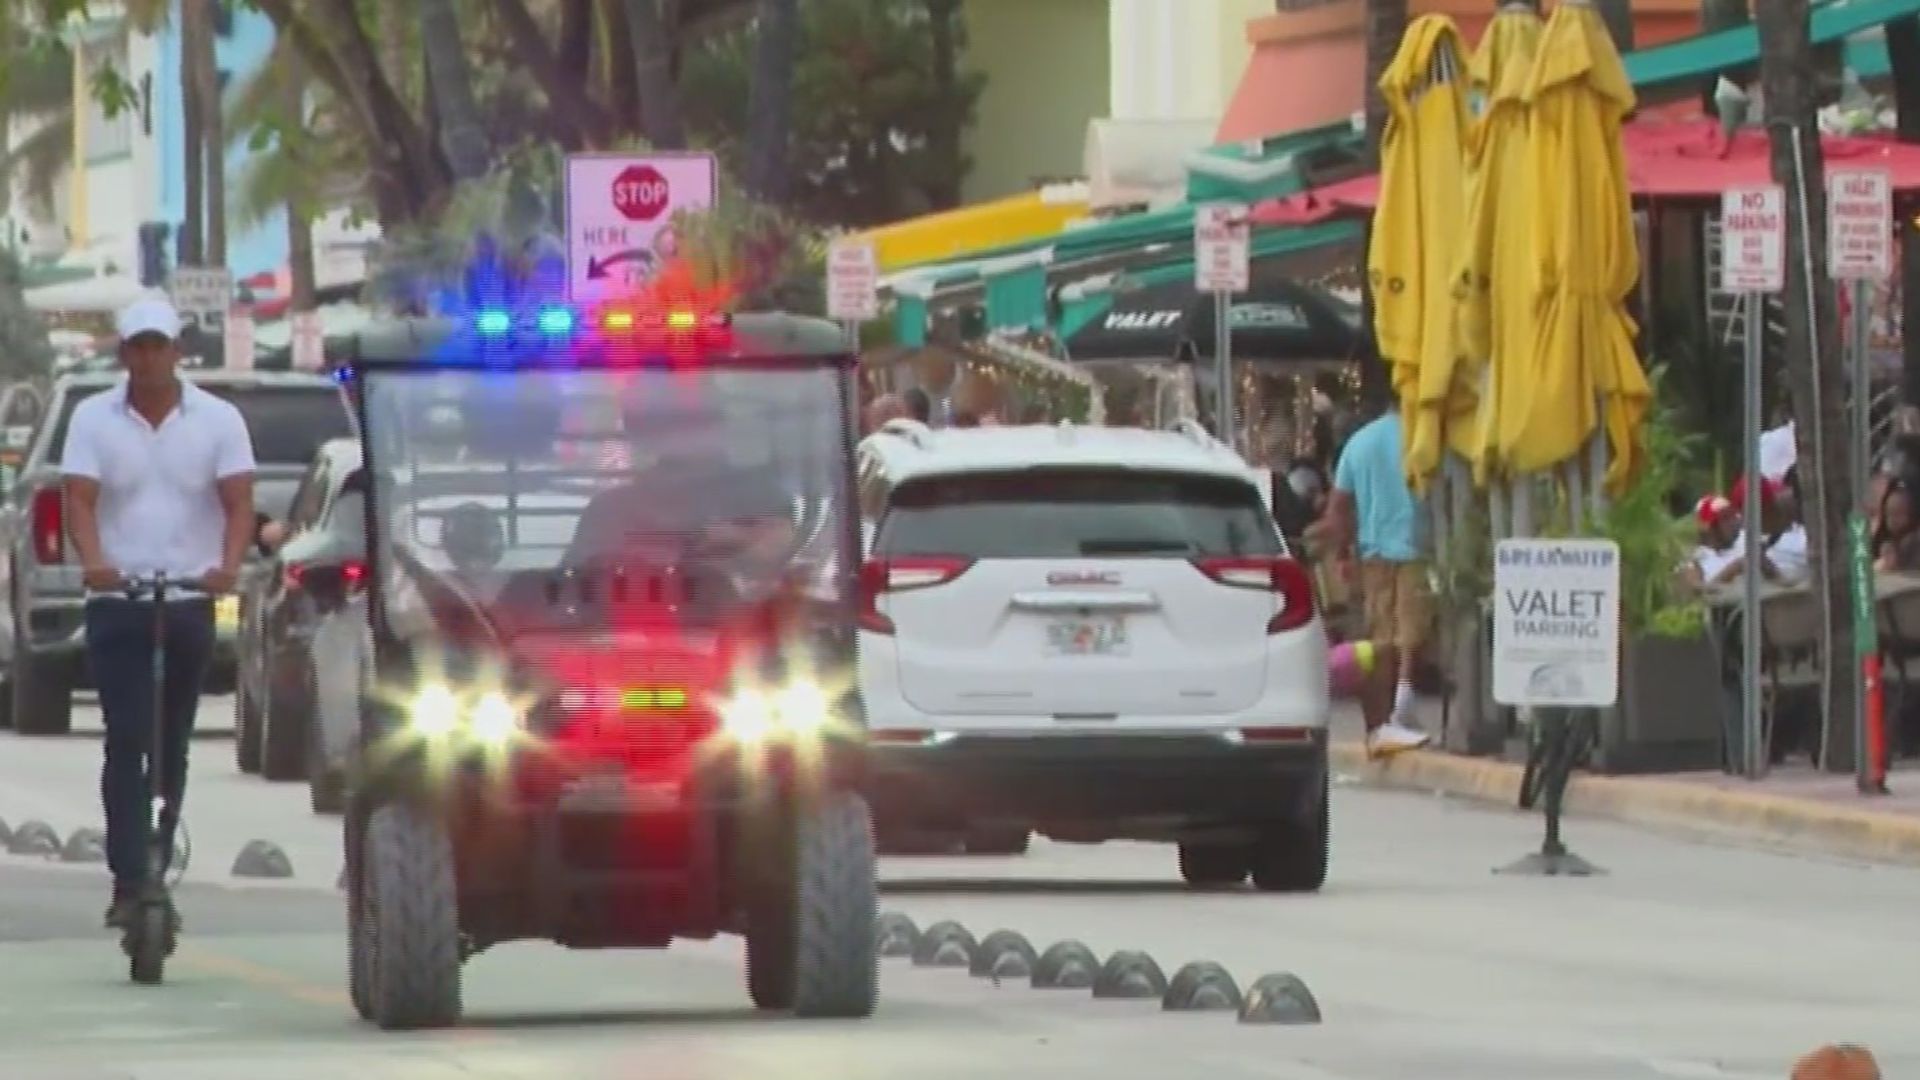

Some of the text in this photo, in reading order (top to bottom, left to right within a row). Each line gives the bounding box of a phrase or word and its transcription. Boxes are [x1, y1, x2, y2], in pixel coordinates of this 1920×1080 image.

[614, 181, 667, 205] STOP
[1741, 192, 1765, 208] NO
[584, 227, 629, 245] HERE
[1104, 310, 1181, 329] VALET
[1505, 588, 1606, 618] VALET
[1513, 620, 1600, 639] PARKING
